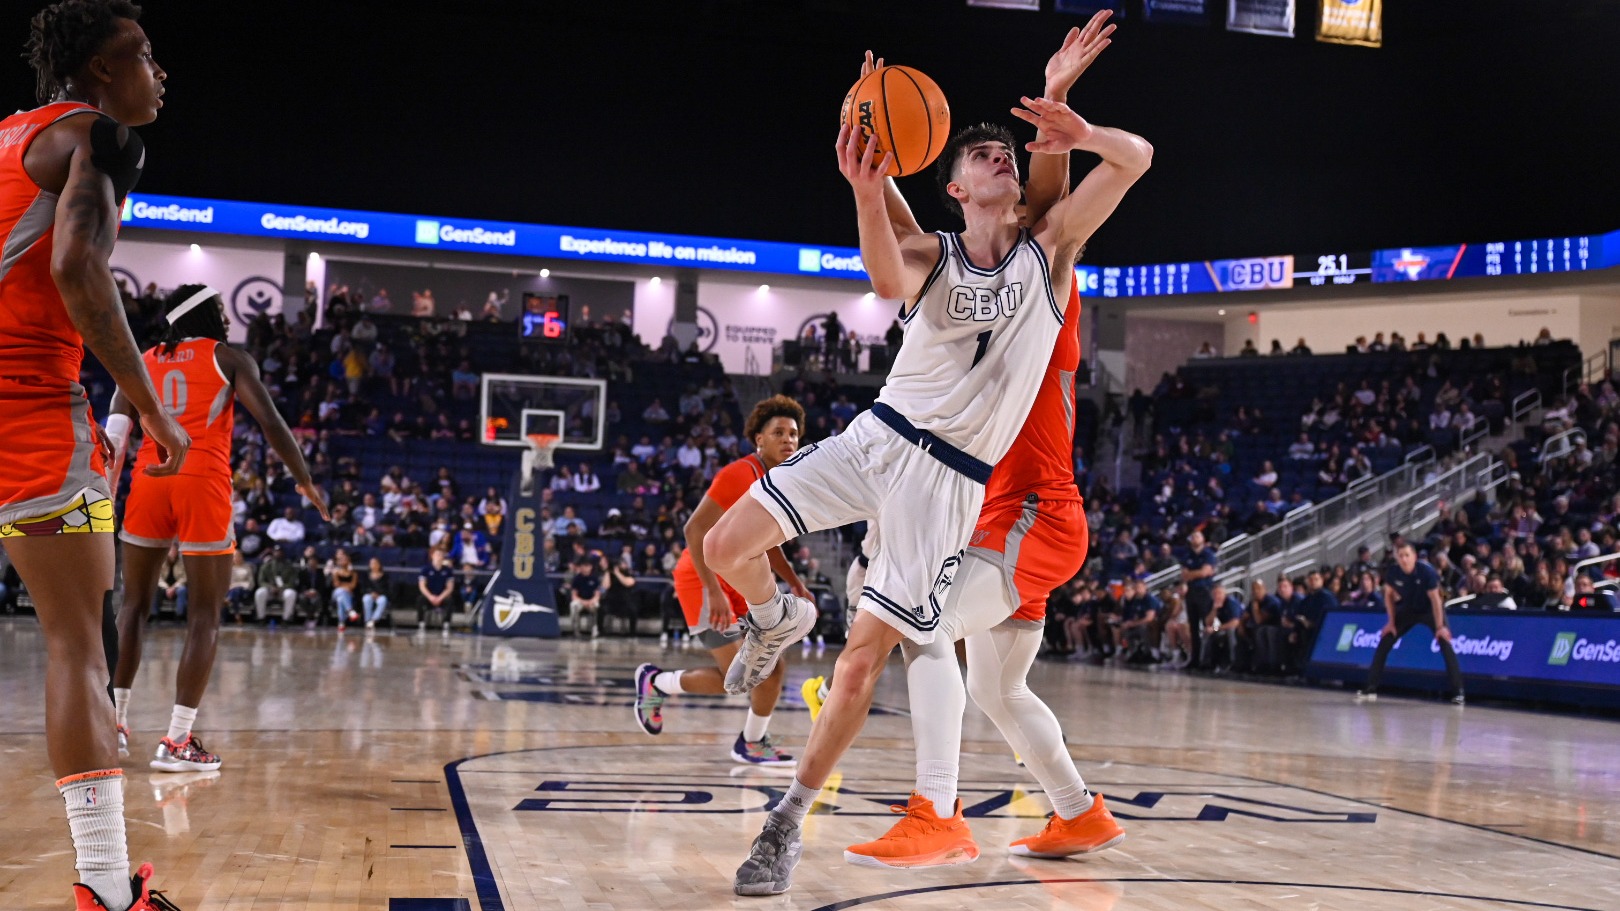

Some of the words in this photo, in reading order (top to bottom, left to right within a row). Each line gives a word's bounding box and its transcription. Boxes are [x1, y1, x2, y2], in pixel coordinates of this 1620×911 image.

[132, 201, 214, 225] GenSend
[260, 213, 370, 240] GenSend.org
[439, 225, 516, 247] GenSend
[559, 235, 648, 257] Experience
[647, 241, 673, 258] life
[673, 246, 696, 260] on
[696, 246, 756, 265] mission
[821, 252, 867, 273] GenS
[1231, 260, 1285, 286] CBU
[1317, 254, 1348, 276] 25.1
[946, 281, 1023, 322] CBU
[543, 311, 561, 338] 6
[725, 324, 777, 335] EQUIPPED
[970, 330, 994, 371] 1
[163, 369, 188, 417] 0
[512, 507, 536, 580] CBU
